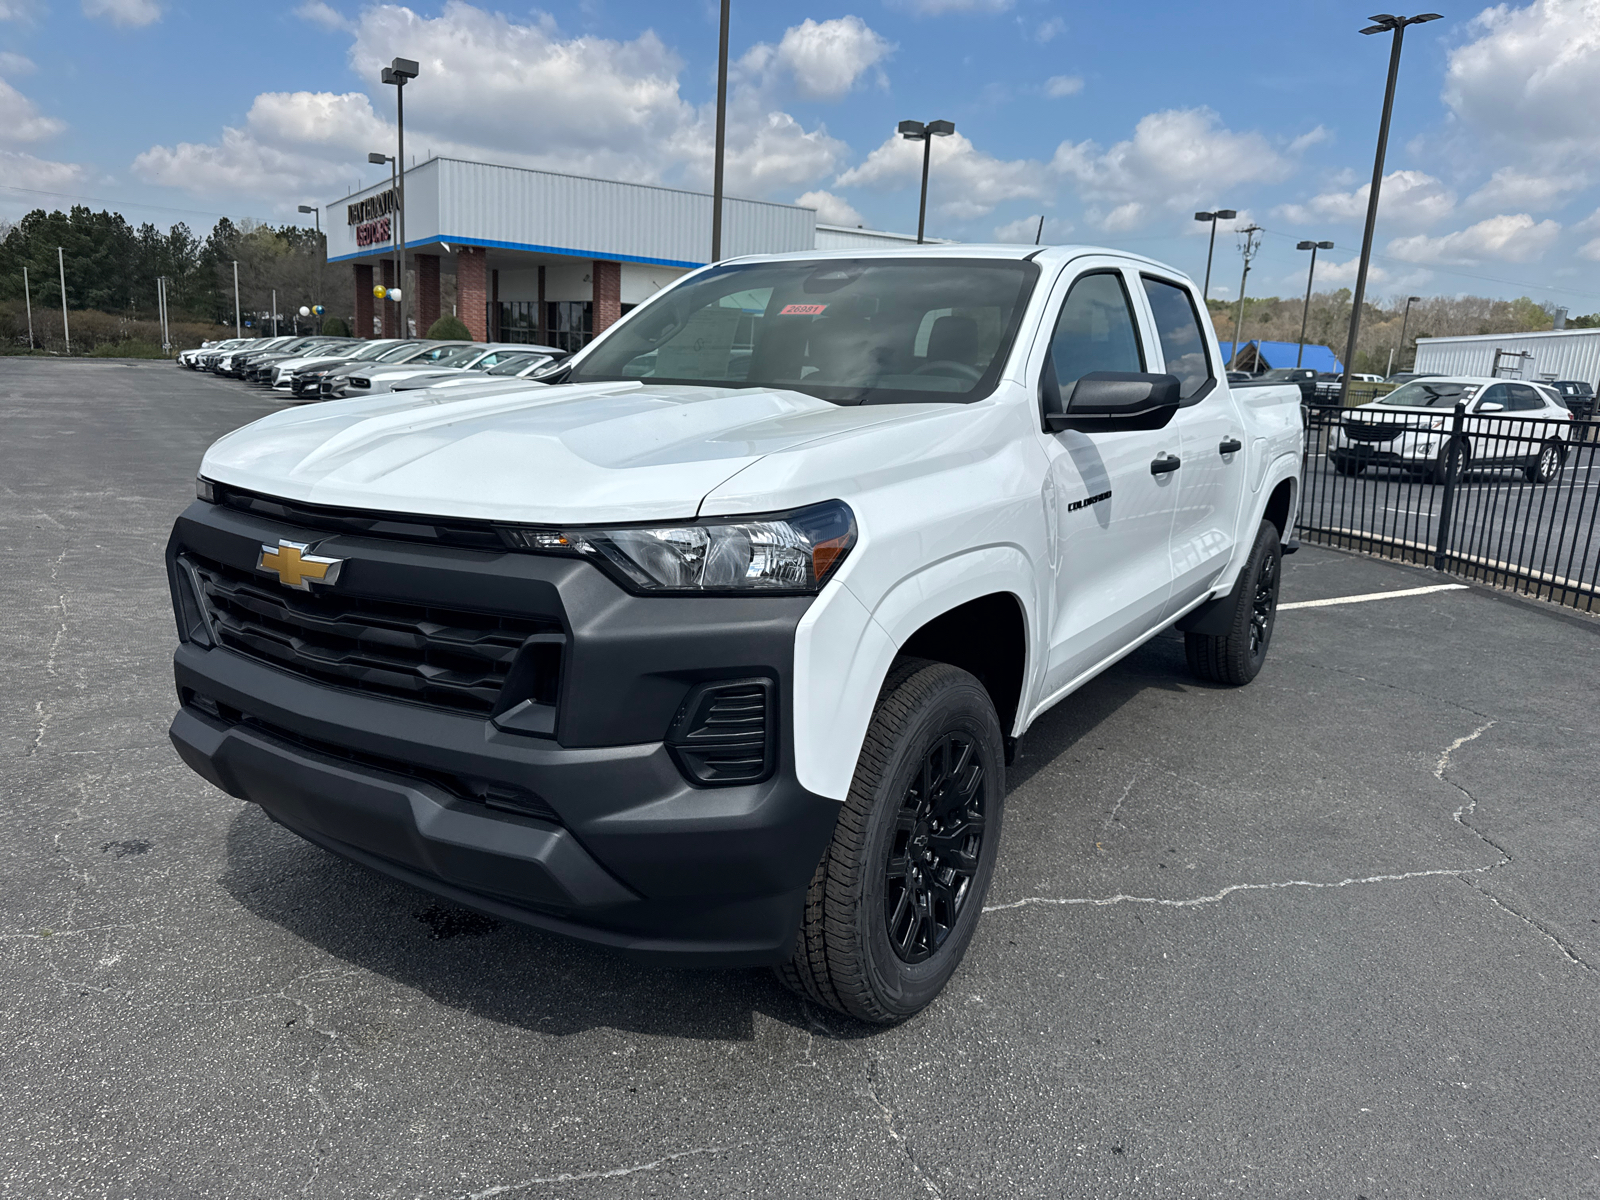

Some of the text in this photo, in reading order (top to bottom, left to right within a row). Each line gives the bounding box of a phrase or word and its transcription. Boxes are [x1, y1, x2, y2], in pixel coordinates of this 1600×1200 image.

[356, 217, 390, 246] USED CARS
[1067, 490, 1112, 512] COLORADO
